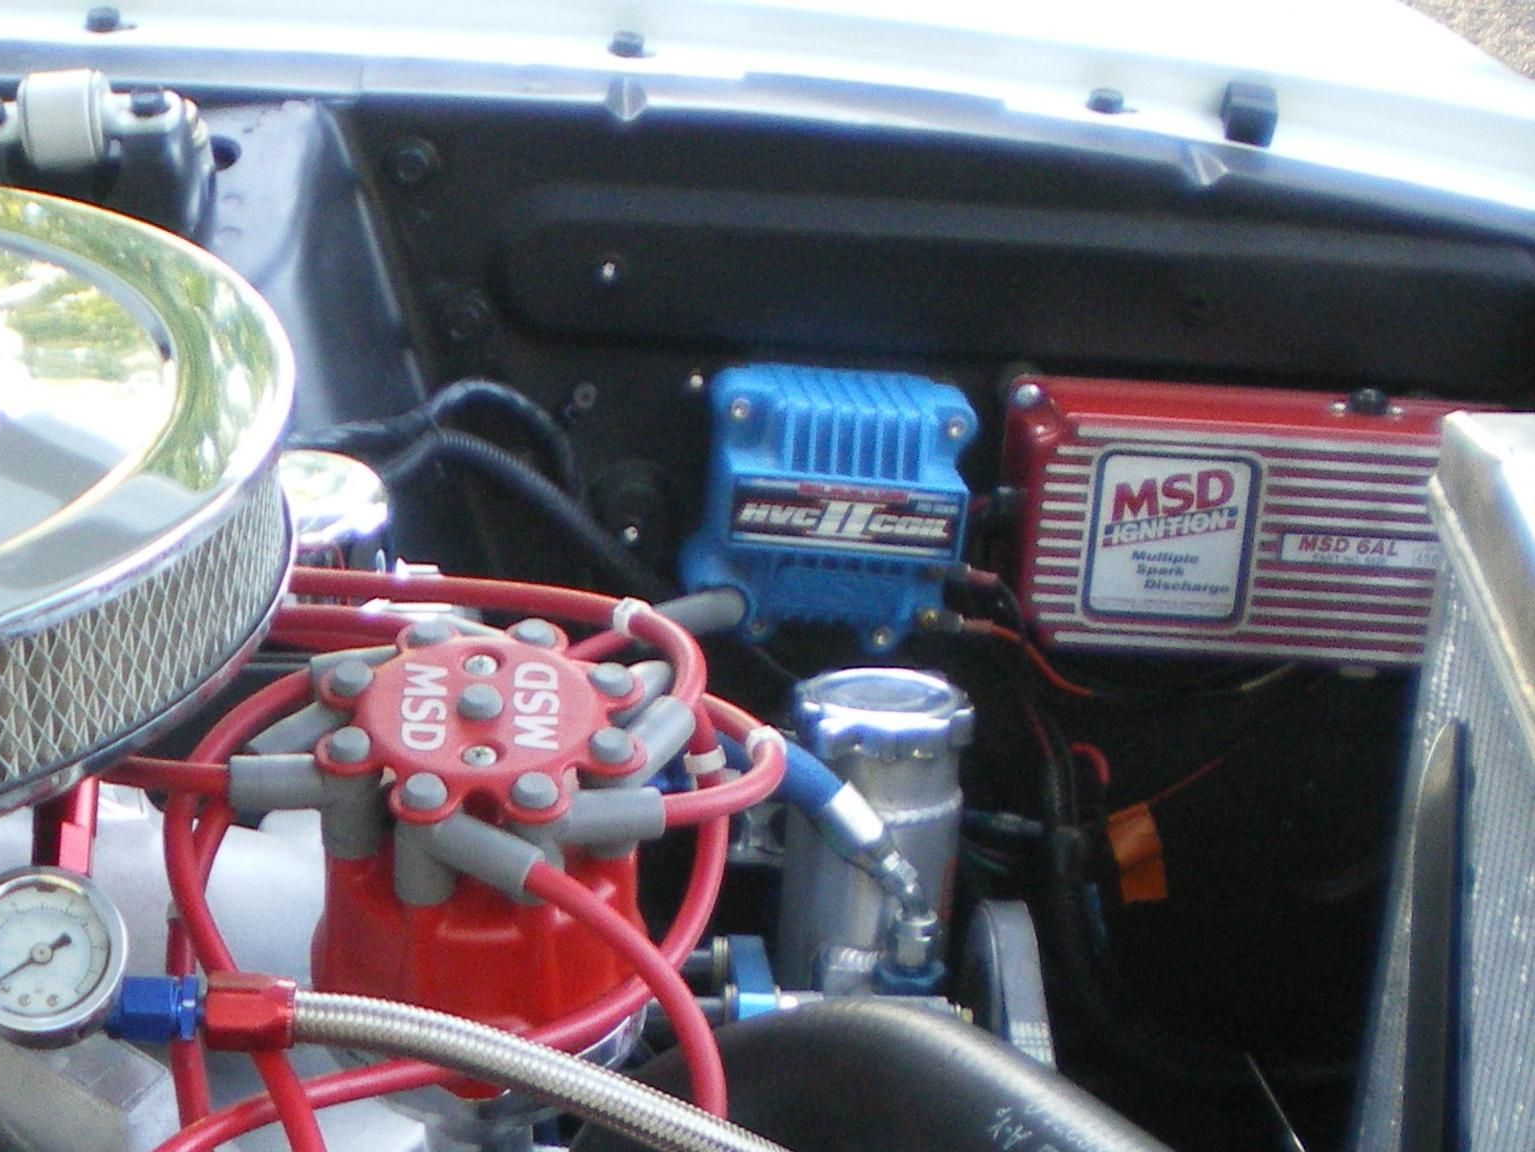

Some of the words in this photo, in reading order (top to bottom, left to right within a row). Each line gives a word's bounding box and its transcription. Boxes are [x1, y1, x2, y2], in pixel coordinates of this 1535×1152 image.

[1111, 469, 1235, 522] MSD
[739, 502, 822, 526] HVC
[868, 513, 950, 538] COIL
[1110, 508, 1230, 544] IGNITION
[1131, 550, 1200, 565] Multiple
[1298, 535, 1350, 554] MSD
[1356, 538, 1400, 556] 6AL
[1136, 563, 1185, 577] Spark
[1143, 579, 1230, 596] Discharge
[401, 662, 448, 751] MSD
[513, 661, 560, 751] MSD
